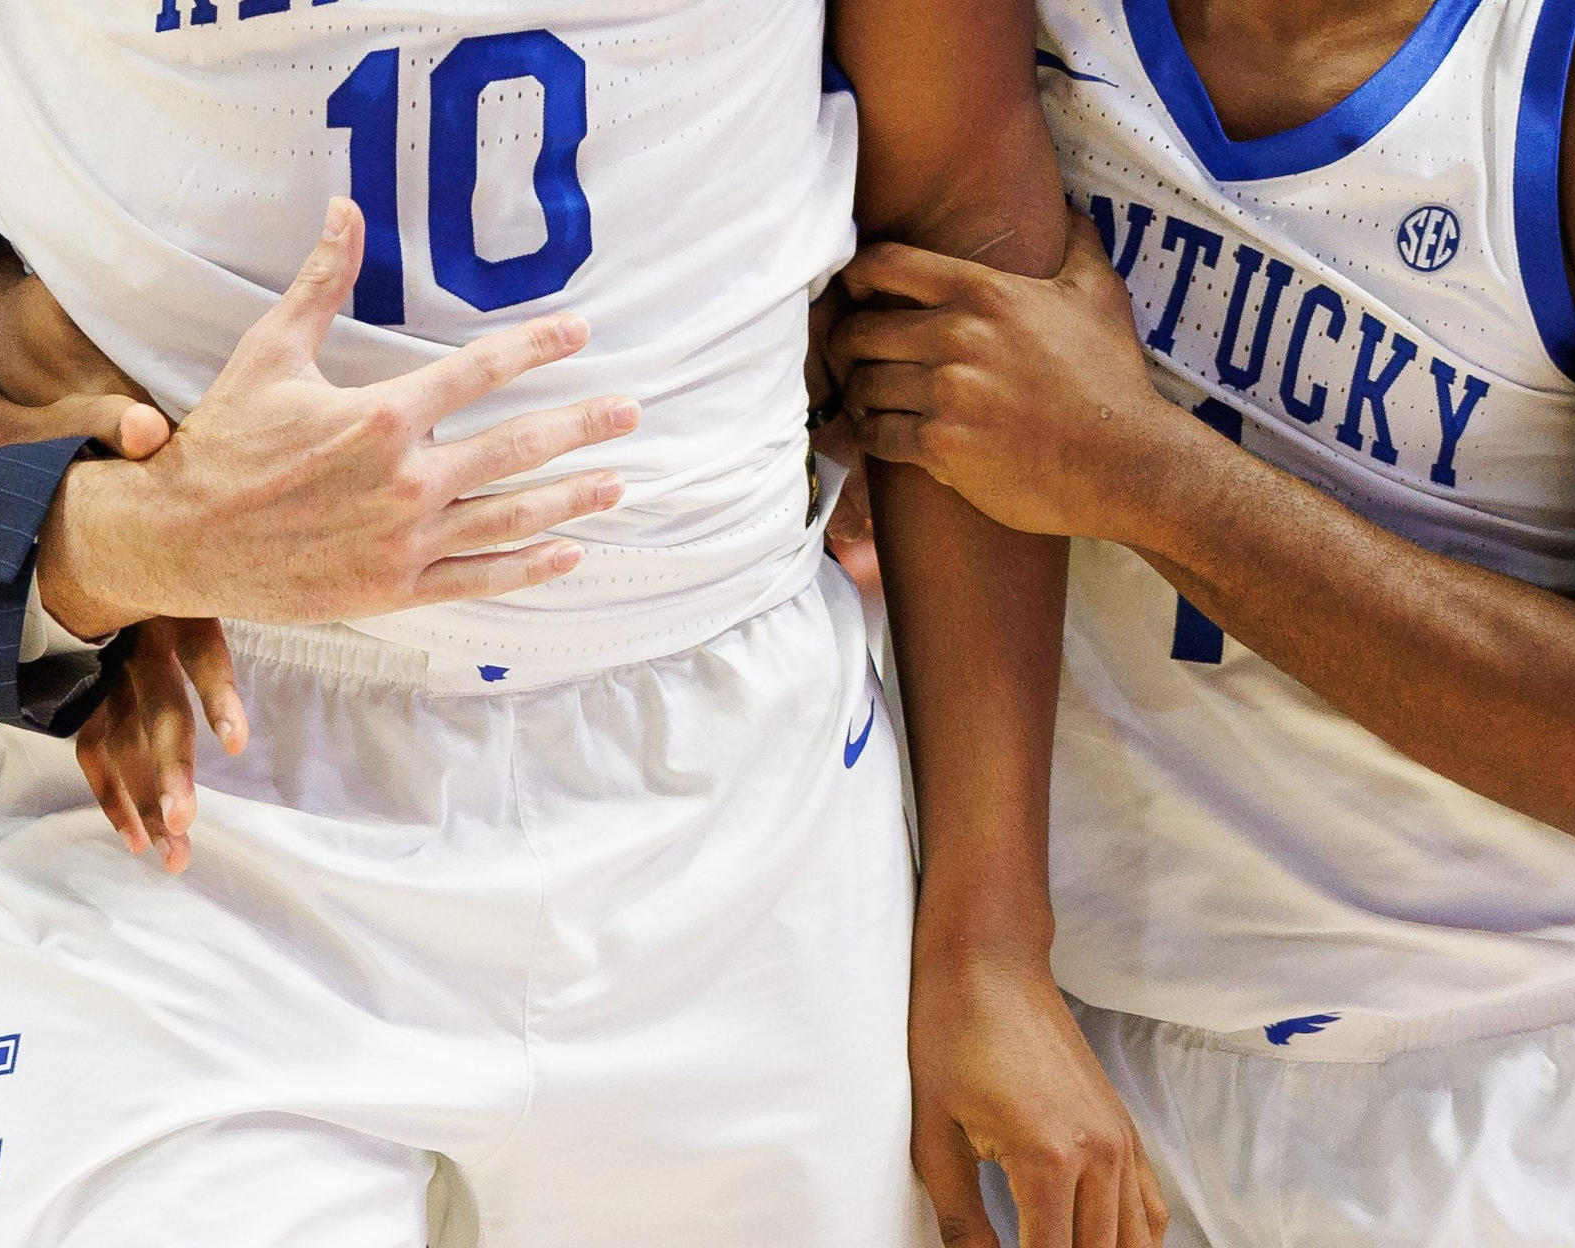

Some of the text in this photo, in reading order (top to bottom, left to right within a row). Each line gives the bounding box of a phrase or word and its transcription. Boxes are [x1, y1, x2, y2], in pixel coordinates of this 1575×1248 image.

[327, 29, 593, 326] 10
[1400, 209, 1457, 269] SEC
[1066, 193, 1490, 488] NTUCKY
